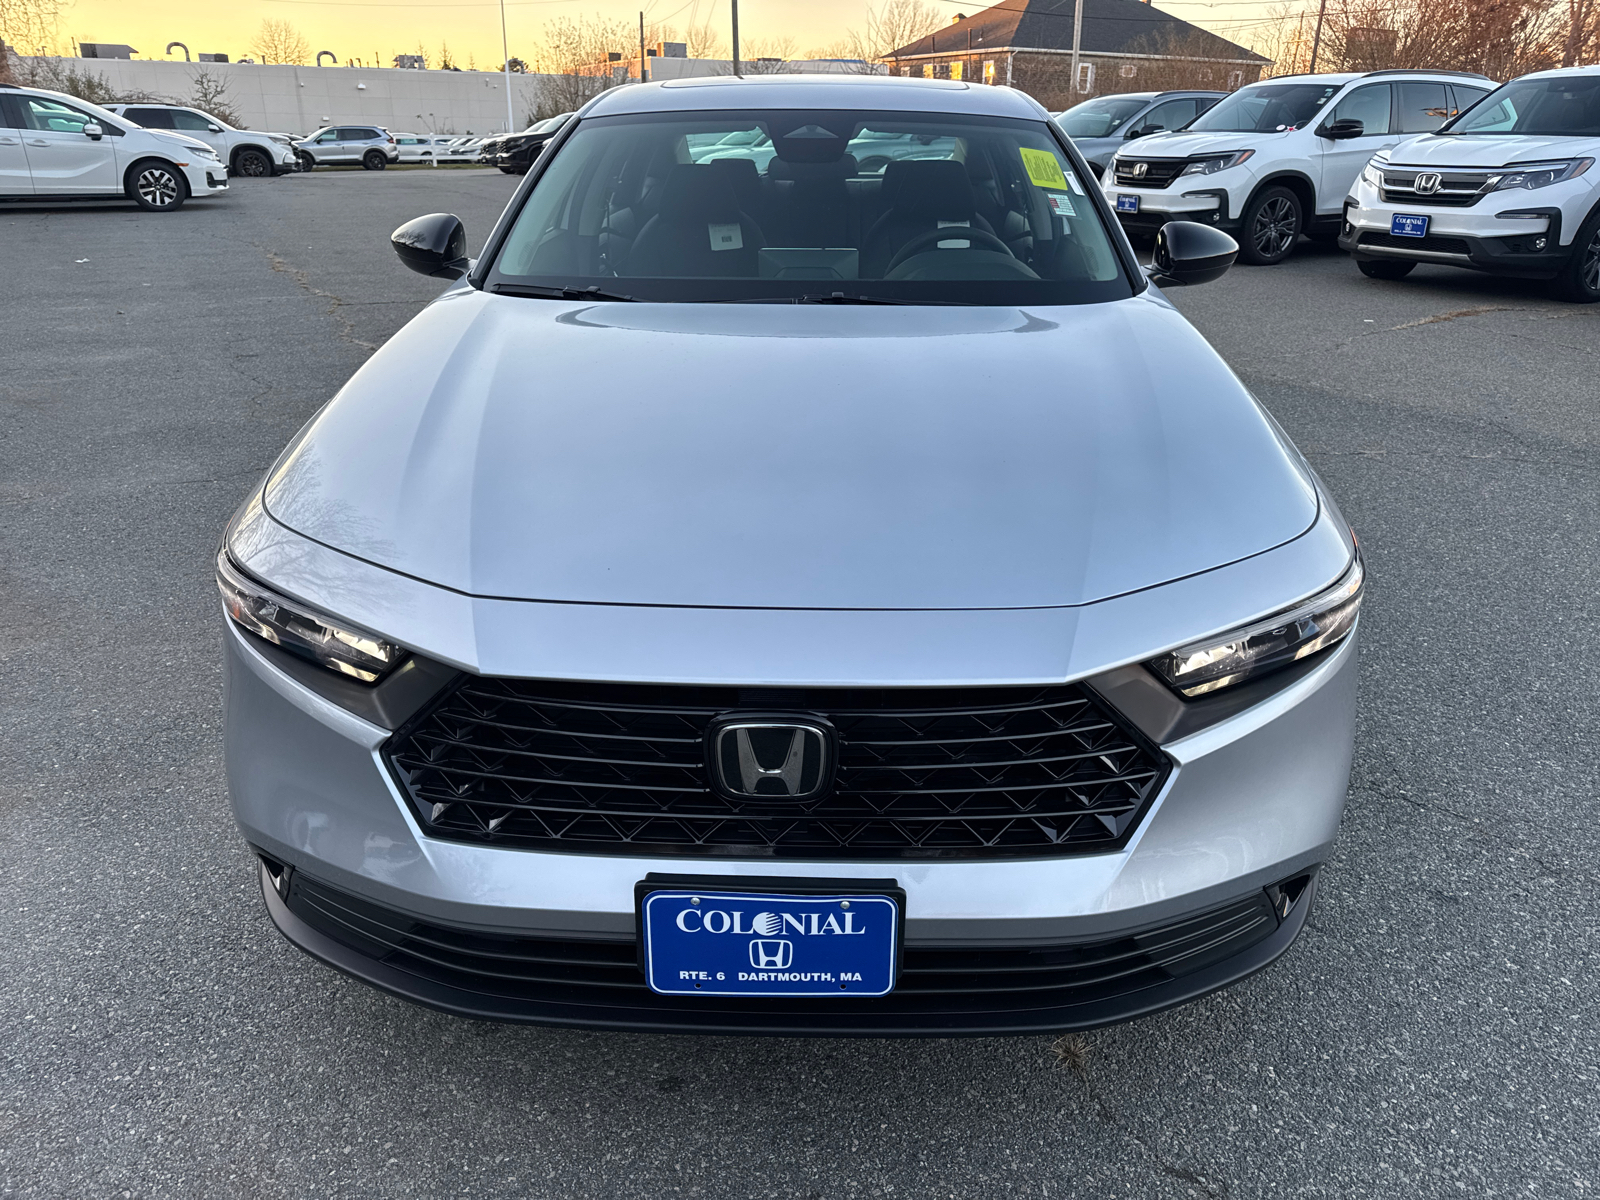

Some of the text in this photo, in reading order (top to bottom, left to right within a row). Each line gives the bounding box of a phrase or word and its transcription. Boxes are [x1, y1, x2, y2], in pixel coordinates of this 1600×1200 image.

[676, 908, 866, 937] COLONIAL
[679, 970, 863, 982] RTE. 6 DARTMOUTH, MA
